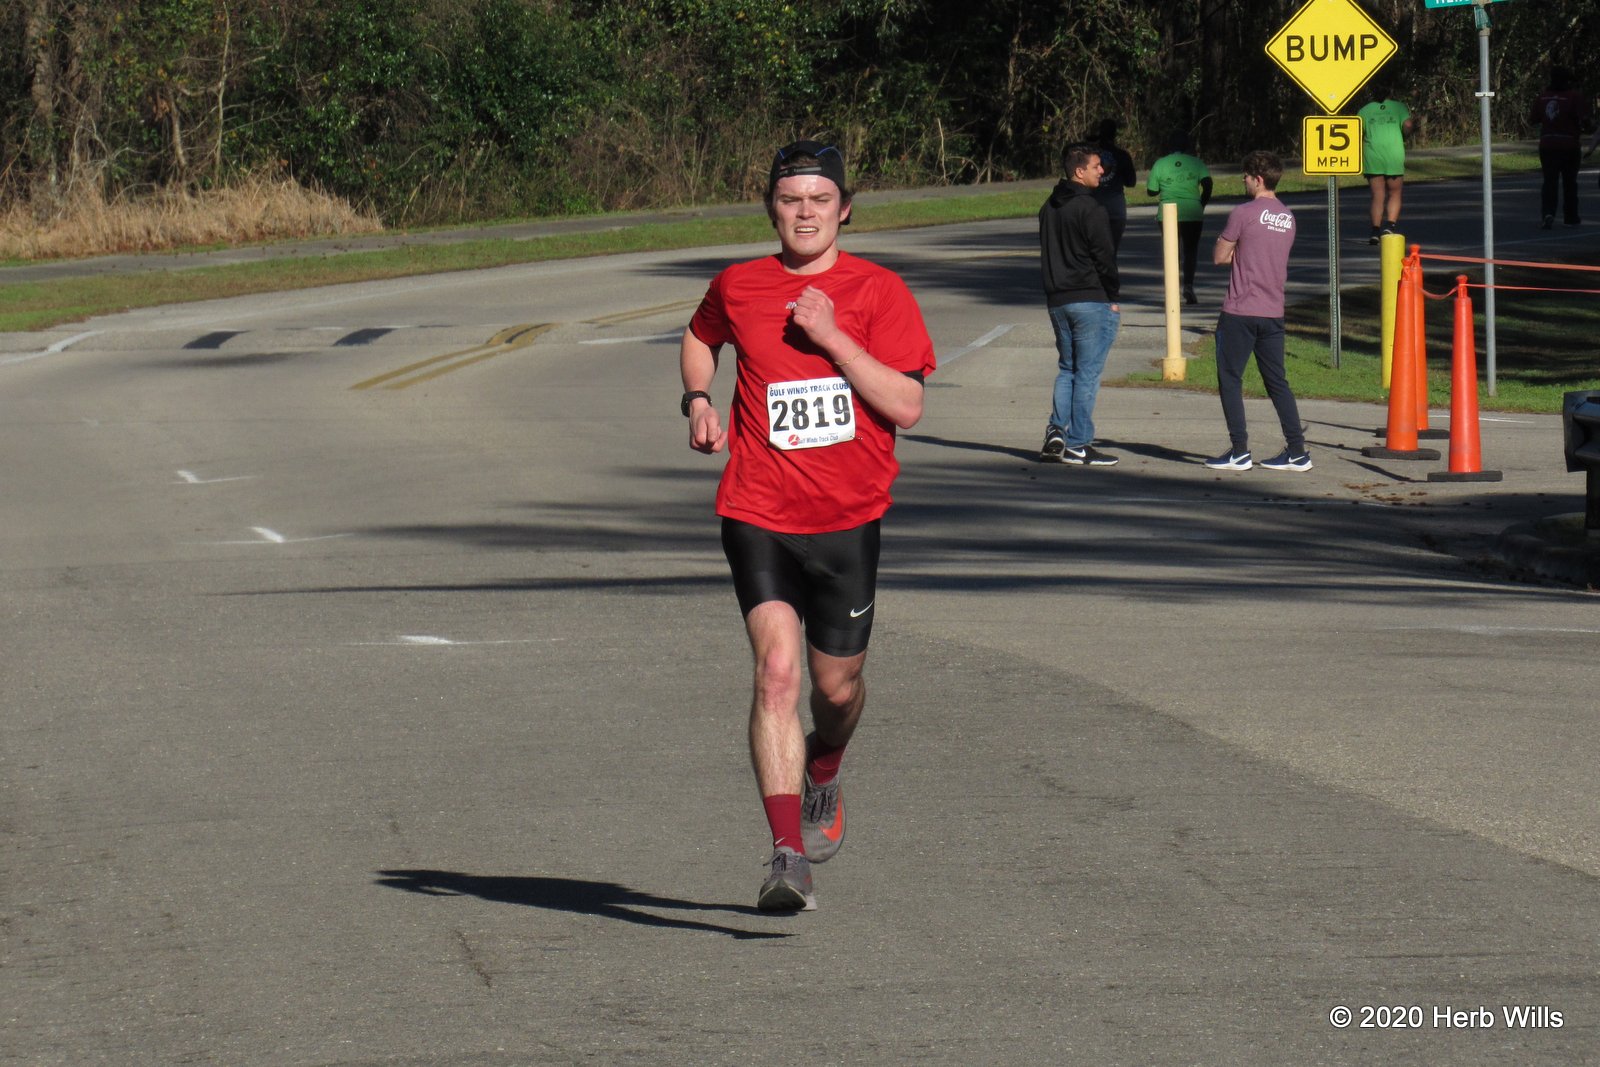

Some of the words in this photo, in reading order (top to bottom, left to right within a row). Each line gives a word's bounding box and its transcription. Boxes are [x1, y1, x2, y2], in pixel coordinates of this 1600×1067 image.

[1286, 34, 1378, 62] BUMP
[1315, 124, 1350, 151] 15
[1317, 156, 1349, 167] MPH
[769, 388, 785, 397] GULF
[787, 386, 808, 395] WINDS
[810, 384, 831, 392] TRACK
[771, 394, 851, 432] 2819
